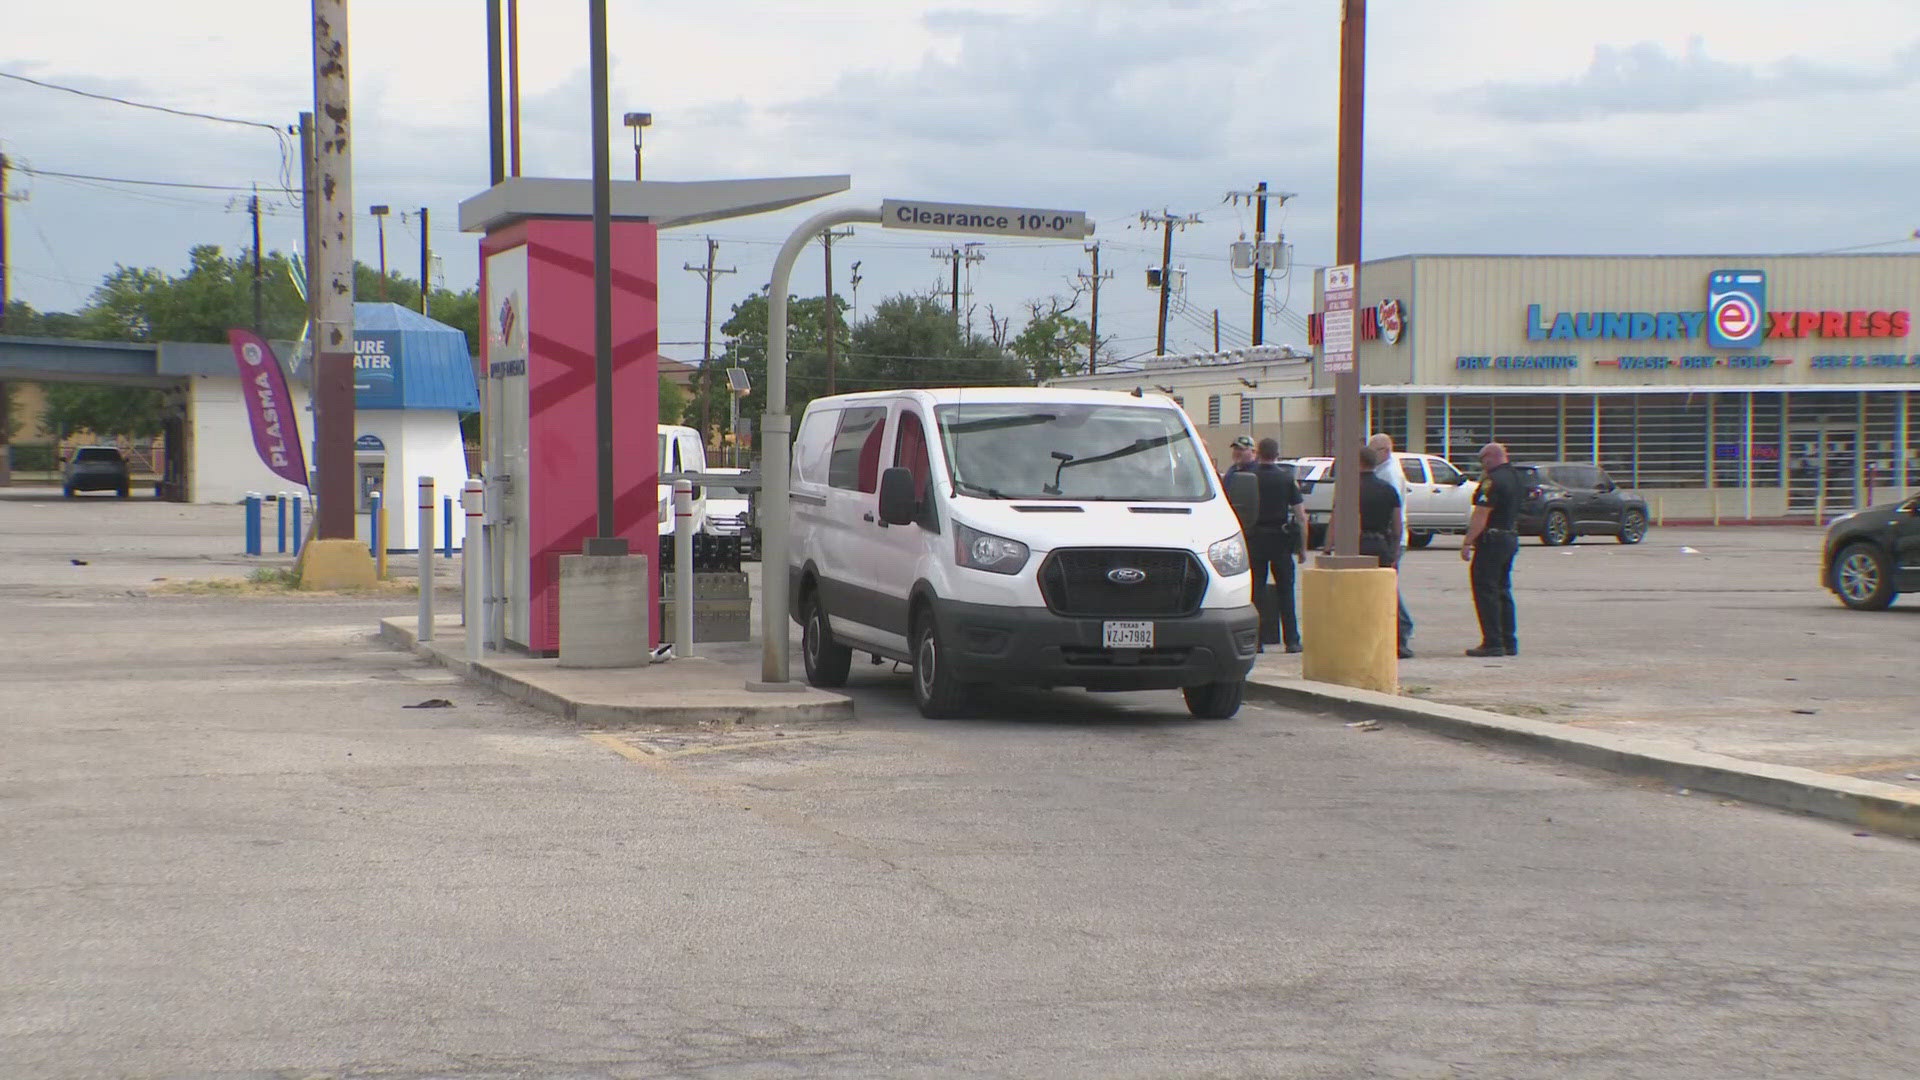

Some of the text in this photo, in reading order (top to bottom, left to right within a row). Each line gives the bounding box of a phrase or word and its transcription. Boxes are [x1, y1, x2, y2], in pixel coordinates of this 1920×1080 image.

[897, 206, 1008, 229] Clearance
[1526, 304, 1706, 342] LAUNDRY
[353, 340, 386, 354] URE
[352, 355, 391, 369] ATER
[1456, 356, 1579, 370] DRY CLEANING
[255, 372, 289, 467] PLASMA
